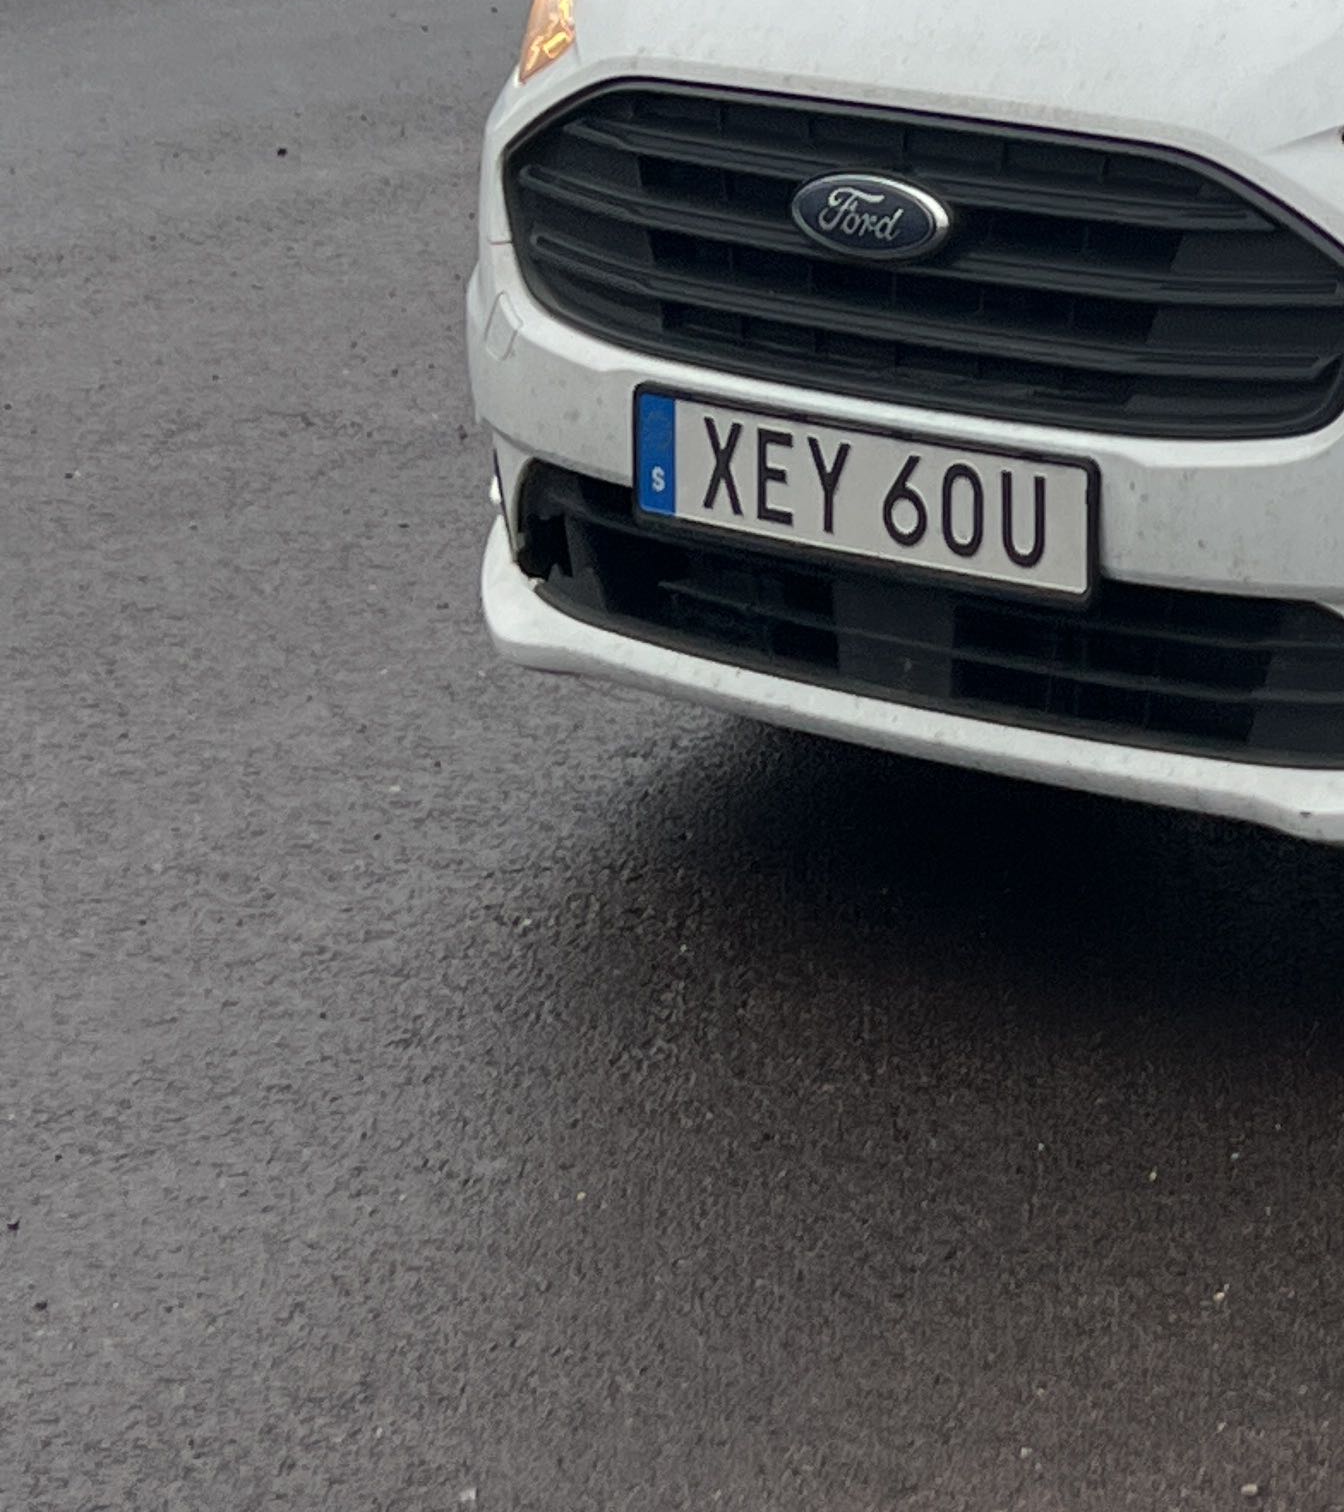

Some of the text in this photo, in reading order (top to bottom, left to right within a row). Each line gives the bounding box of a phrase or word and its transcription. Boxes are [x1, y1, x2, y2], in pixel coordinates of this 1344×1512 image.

[818, 187, 904, 241] Ford
[651, 465, 666, 493] S
[703, 417, 1046, 569] XEY 60U
